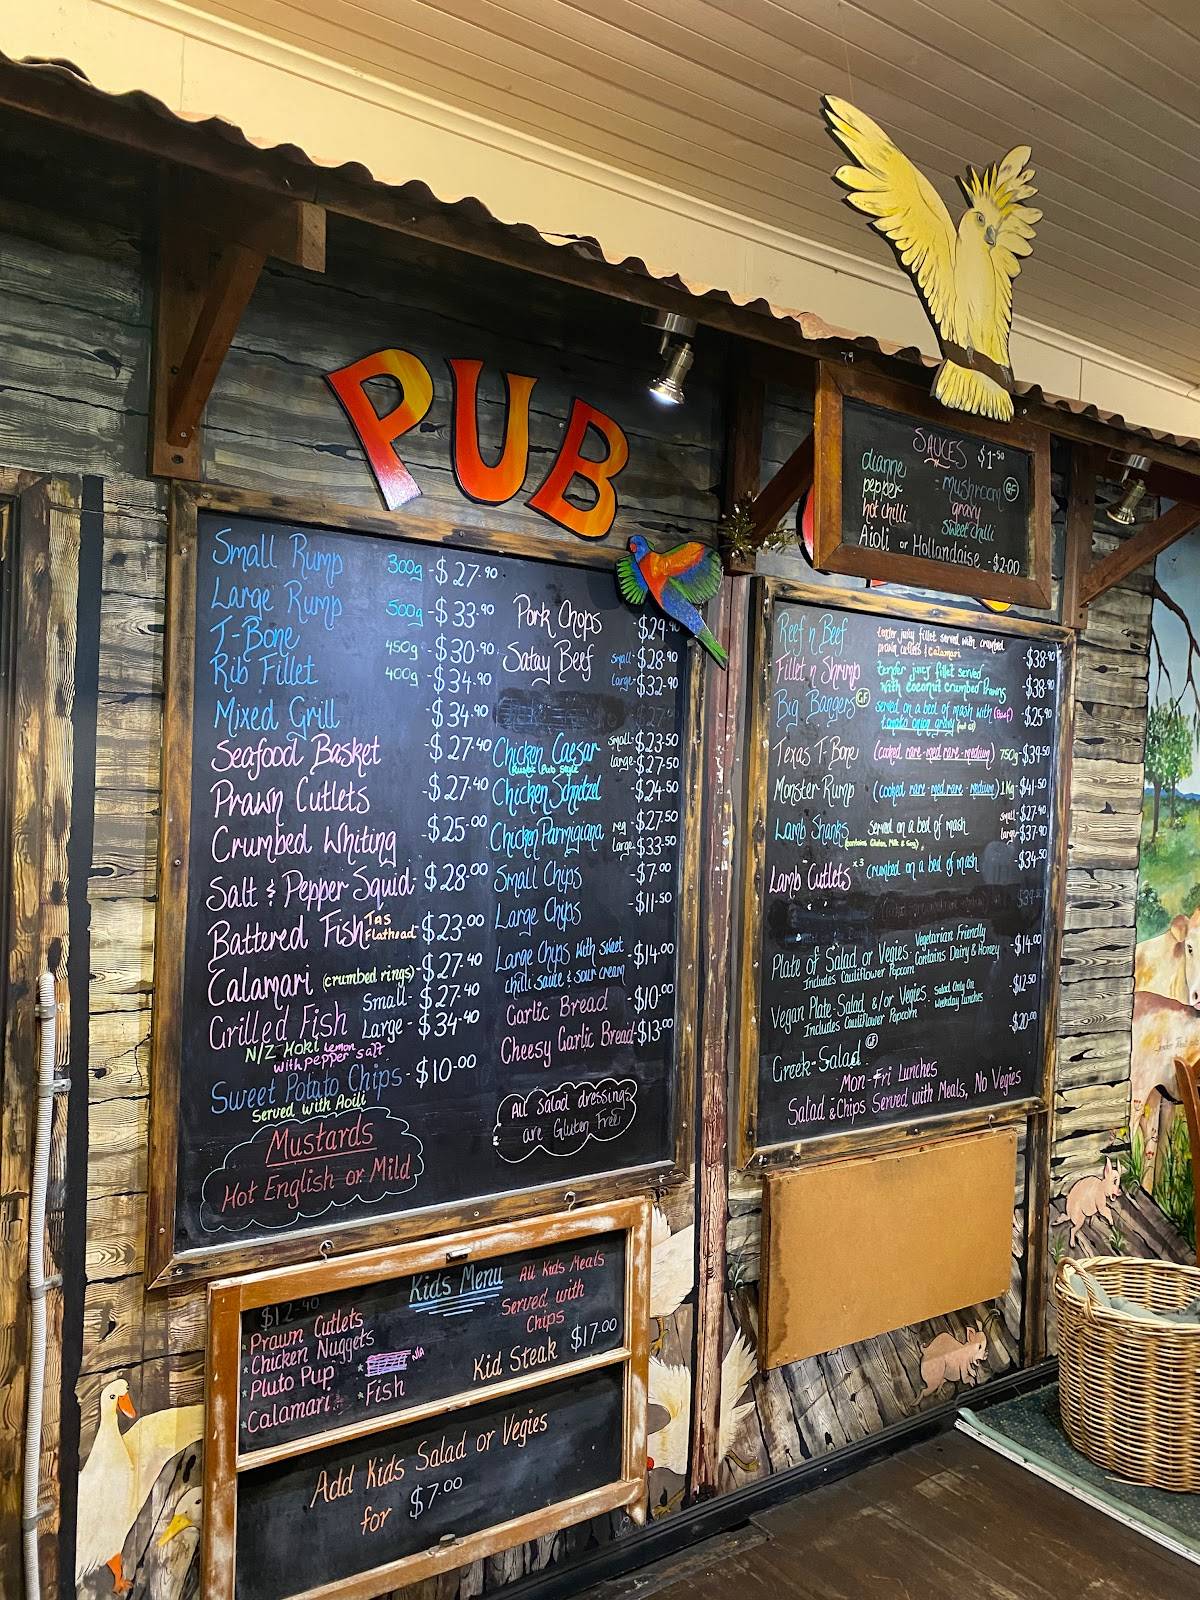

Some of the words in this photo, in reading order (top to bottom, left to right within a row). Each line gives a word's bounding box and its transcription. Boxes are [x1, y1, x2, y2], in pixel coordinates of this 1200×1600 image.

[325, 348, 629, 541] PUB
[913, 427, 967, 469] SAUCES
[861, 448, 906, 482] dianne
[862, 477, 903, 500] pepper
[862, 500, 878, 524] hot
[881, 503, 908, 525] chilli
[951, 502, 982, 524] gravy
[859, 525, 890, 551] Aioli
[900, 540, 909, 550] or
[912, 534, 981, 568] Hollandaise
[970, 522, 995, 543] chilli
[213, 528, 277, 572] Small
[289, 533, 343, 588] Rump
[387, 553, 423, 581] 300g
[211, 577, 274, 618] Large
[284, 579, 342, 630] Rump
[385, 598, 423, 627] 500g
[513, 593, 556, 638] Pork
[558, 600, 603, 641] Chops
[210, 615, 300, 662] T-Bone
[385, 640, 418, 660] 450g
[209, 653, 248, 692] Rib
[258, 653, 319, 686] Fillet
[385, 667, 418, 687] 400g
[503, 642, 550, 686] Satay
[554, 640, 594, 683] Beef
[776, 652, 806, 684] Fillet
[214, 697, 278, 737] Mixed
[287, 696, 340, 740] Grill
[805, 688, 856, 727] Bangers
[211, 737, 304, 781] Seafood
[310, 733, 382, 778] Basket
[493, 736, 543, 775] Chicken
[552, 732, 601, 767] Caesar
[773, 736, 811, 769] Texas
[999, 748, 1019, 766] 750g
[210, 779, 284, 826] Prawn
[296, 776, 370, 814] Cutlets
[492, 778, 552, 816] Chicken
[774, 775, 820, 806] Monster
[822, 774, 855, 808] Rump
[212, 824, 312, 863] Crumbed
[324, 823, 397, 867] Whiting
[490, 821, 540, 860] Chicken
[775, 817, 807, 846] Lamb
[811, 814, 850, 847] Shanks
[934, 814, 943, 840] of
[206, 876, 258, 911] Salt
[281, 870, 349, 911] Pepper
[494, 864, 538, 897] Small
[543, 861, 582, 894] Chips
[769, 865, 802, 899] Lamb
[808, 861, 851, 891] Cutlets
[364, 910, 392, 926] Tas
[364, 925, 417, 942] Flathead
[495, 902, 539, 936] Large
[544, 896, 581, 932] Chips
[208, 915, 308, 973] Battered
[319, 909, 370, 950] Fish
[915, 927, 953, 951] Vegetarian
[957, 923, 986, 943] Friendly
[495, 946, 533, 978] Large
[537, 940, 570, 973] Chips
[772, 953, 800, 980] Plate
[806, 946, 820, 975] of
[826, 944, 857, 973] Salad
[862, 951, 873, 967] or
[914, 947, 946, 966] Contains
[208, 965, 313, 1011] Calamari
[803, 974, 836, 990] Includes
[841, 967, 885, 984] Cauliflower
[209, 1004, 289, 1050] Grilled
[300, 1001, 348, 1040] Fish
[362, 1019, 403, 1043] Large
[506, 1001, 550, 1026] Garlic
[560, 988, 608, 1018] Bread
[771, 1004, 804, 1034] Vegan
[803, 1019, 840, 1038] Includes
[844, 1012, 885, 1029] Cauliflower
[304, 1052, 349, 1072] pepper
[501, 1036, 551, 1068] Cheesy
[558, 1023, 595, 1052] Garlic
[211, 1077, 275, 1115] Sweet
[286, 1072, 339, 1105] Potato
[349, 1063, 402, 1101] Chips
[839, 1067, 892, 1094] Mon-Fri
[897, 1057, 938, 1082] Lunches
[252, 1104, 295, 1123] Served
[302, 1098, 331, 1117] with
[511, 1100, 528, 1119] All
[537, 1091, 569, 1115] salad
[578, 1087, 631, 1111] dressings
[788, 1097, 825, 1126] Salad
[872, 1091, 908, 1114] Served
[911, 1082, 933, 1106] with
[974, 1069, 988, 1094] No
[991, 1066, 1022, 1096] Vegies
[266, 1114, 374, 1163] Mustards
[522, 1126, 543, 1143] are
[553, 1117, 589, 1140] Gluten
[222, 1184, 258, 1213] Hot
[264, 1165, 335, 1209] English
[369, 1154, 411, 1183] Mild
[409, 1272, 451, 1303] Kids
[459, 1263, 504, 1294] Menu
[519, 1265, 536, 1282] All
[542, 1259, 565, 1277] Kids
[569, 1250, 605, 1272] Meals
[501, 1288, 548, 1316] Served
[555, 1279, 585, 1304] with
[250, 1327, 303, 1355] Prawn
[314, 1307, 364, 1337] Cutlets
[526, 1309, 565, 1333] Chips
[251, 1345, 308, 1375] Chicken
[317, 1328, 375, 1365] Nuggets
[472, 1350, 502, 1381] Kid
[509, 1336, 558, 1371] Steak
[250, 1373, 294, 1400] Pluto
[301, 1364, 335, 1390] Pup
[365, 1375, 406, 1407] Fish
[247, 1387, 331, 1434] Calamari
[309, 1464, 355, 1508] Add
[365, 1453, 405, 1490] Kids
[415, 1430, 467, 1471] Salad
[476, 1429, 496, 1451] or
[502, 1409, 548, 1448] Vegies
[360, 1504, 392, 1536] for
